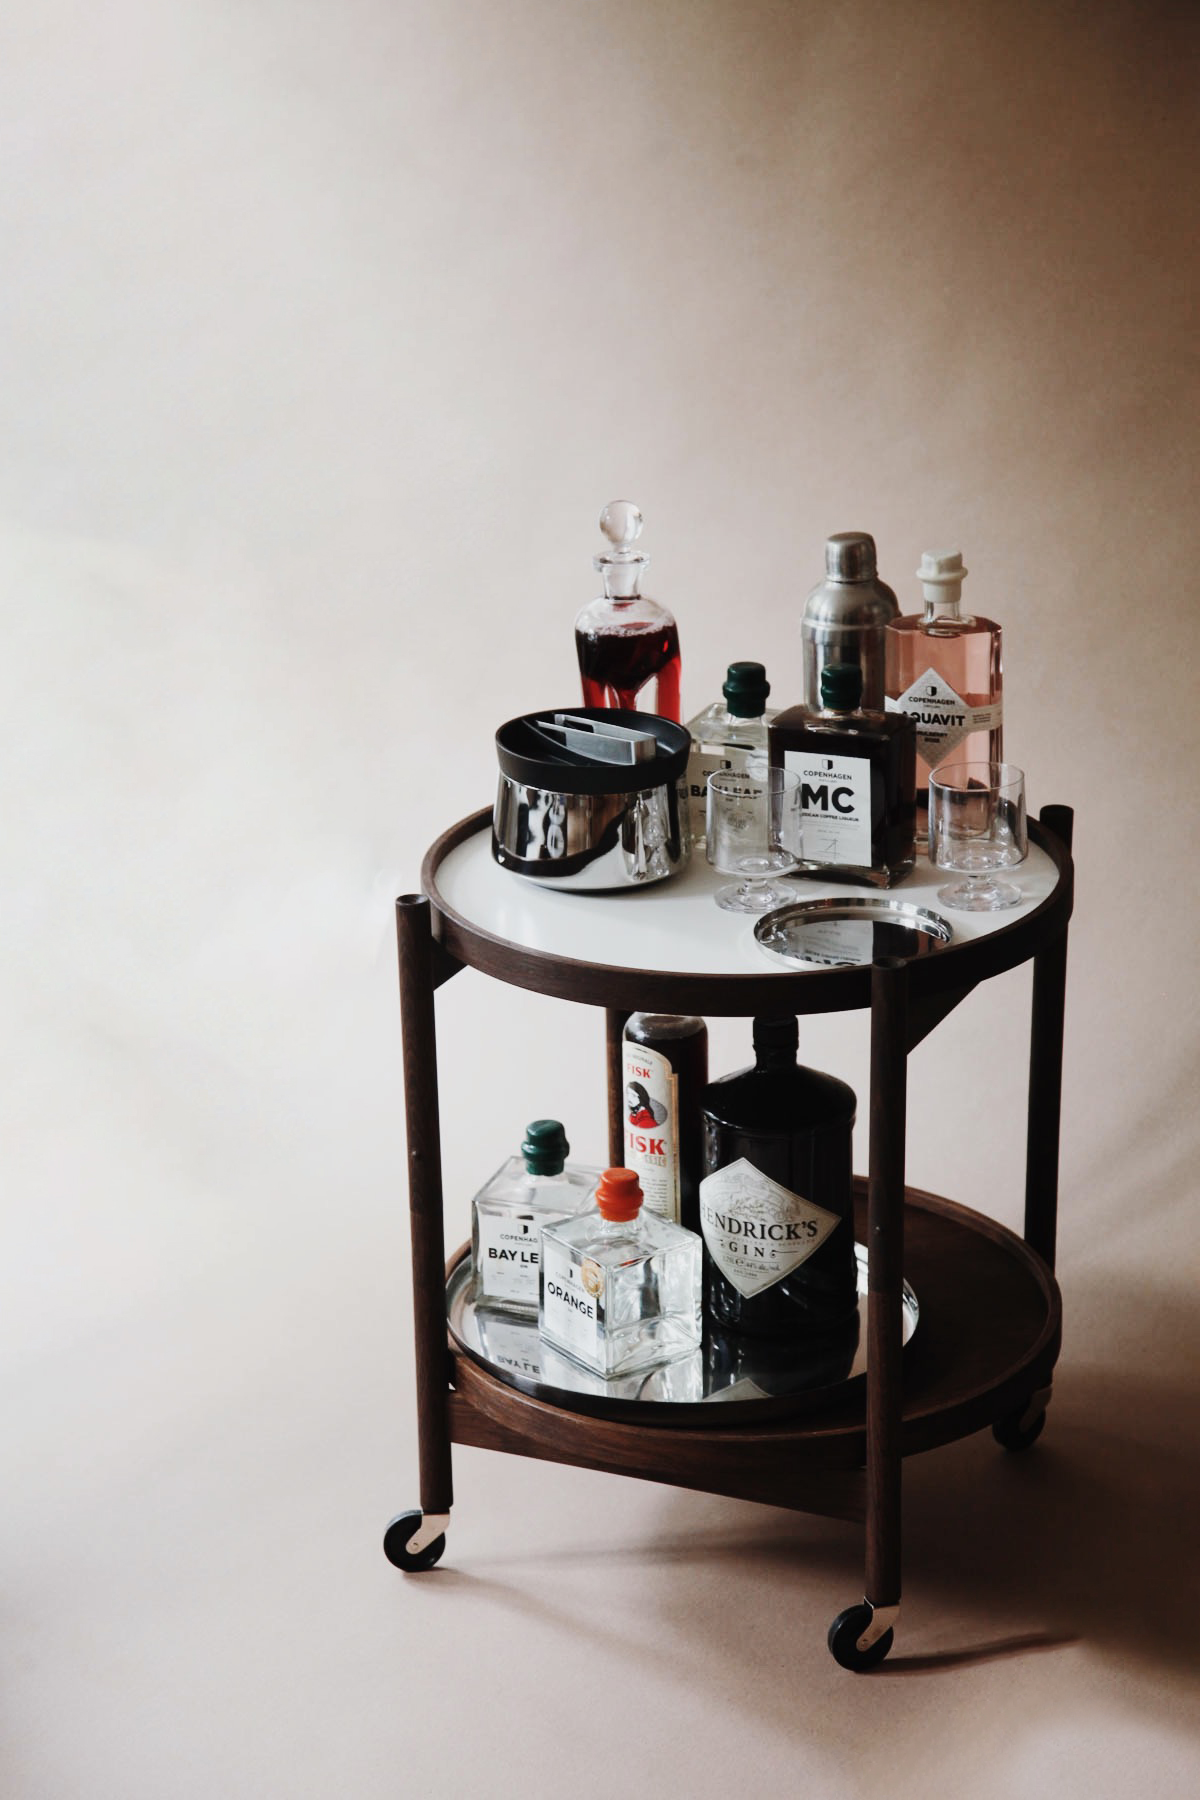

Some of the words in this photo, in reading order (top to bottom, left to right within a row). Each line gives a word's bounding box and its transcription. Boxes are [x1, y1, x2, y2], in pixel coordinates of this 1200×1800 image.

[908, 696, 956, 706] COPENHAGEN
[902, 711, 965, 727] QUAVIT
[803, 770, 852, 780] COPENHAGEN
[801, 783, 855, 814] MC
[488, 1247, 517, 1261] BAY
[728, 1241, 765, 1258] GIN
[547, 1281, 594, 1320] ORANGE
